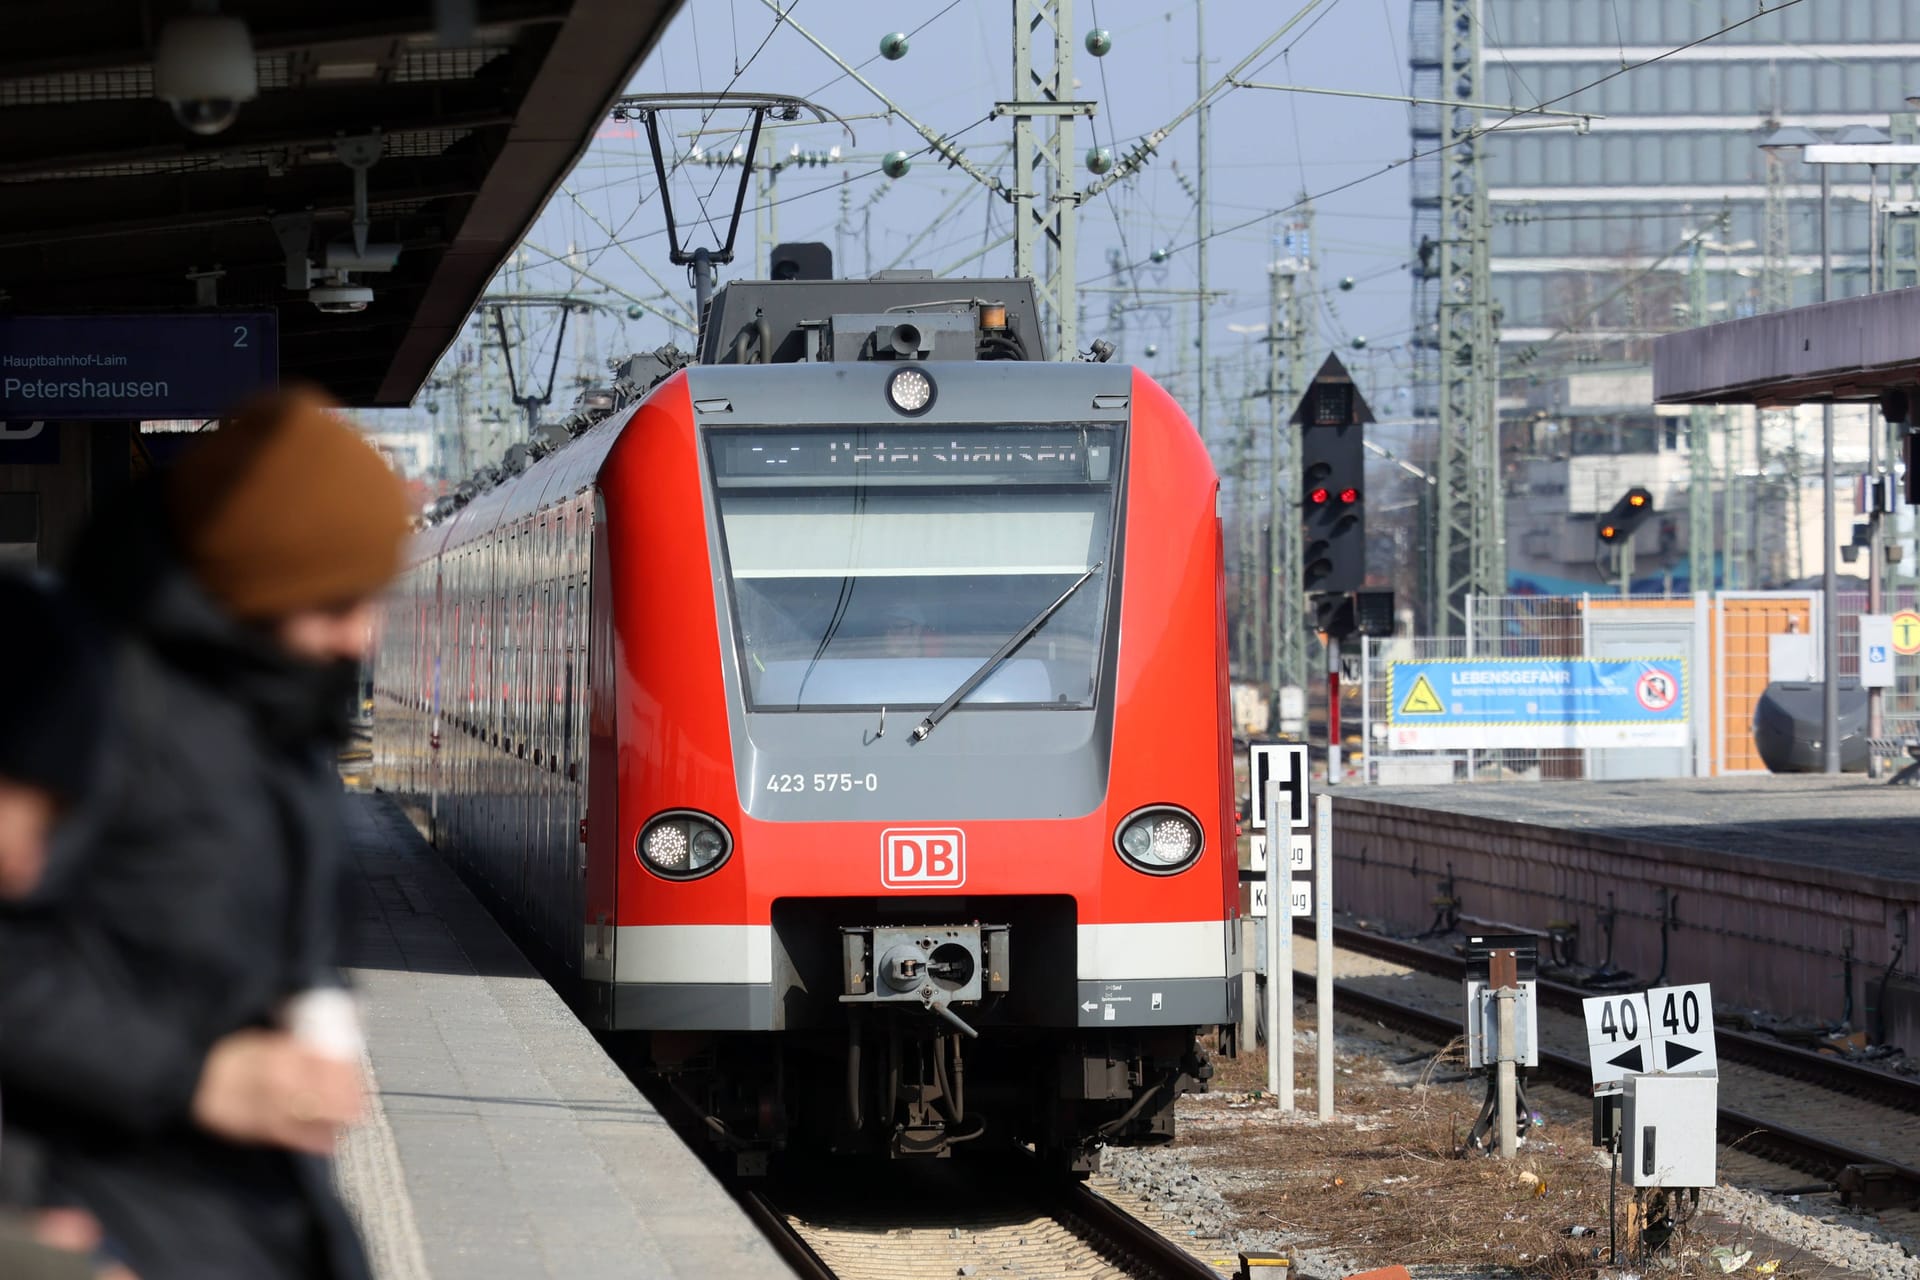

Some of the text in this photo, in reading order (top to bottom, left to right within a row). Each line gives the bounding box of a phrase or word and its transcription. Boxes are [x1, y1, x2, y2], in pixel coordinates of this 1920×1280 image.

[233, 326, 248, 348] 2
[3, 355, 127, 369] Hauptbahnhof-Laim
[4, 377, 169, 399] Petershausen
[766, 773, 878, 793] 423 575-0
[1258, 752, 1302, 821] H
[893, 839, 954, 877] DB
[1601, 998, 1638, 1043] 40
[1662, 990, 1700, 1036] 40
